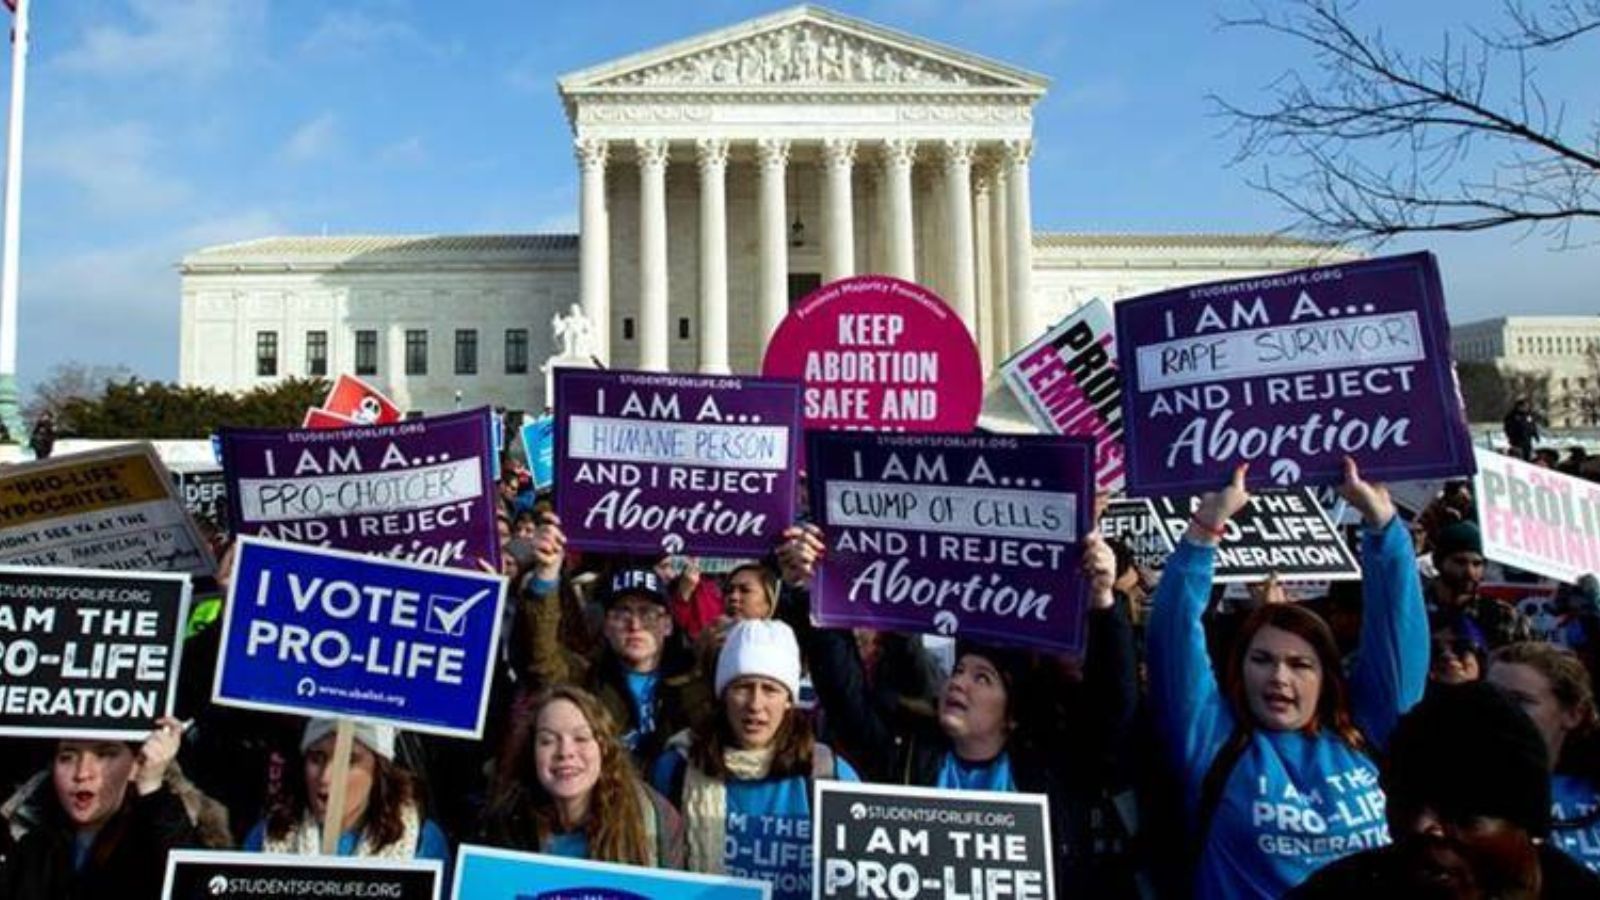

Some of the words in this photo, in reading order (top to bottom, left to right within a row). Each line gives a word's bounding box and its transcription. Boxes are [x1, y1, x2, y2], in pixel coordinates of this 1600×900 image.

[838, 313, 904, 346] KEEP
[1165, 310, 1174, 337] I
[1195, 297, 1270, 333] AM
[1290, 290, 1376, 321] A...
[1161, 338, 1228, 375] RAPE
[1256, 317, 1411, 363] SURVIVOR
[805, 351, 938, 383] ABORTION
[597, 389, 604, 414] I
[620, 391, 681, 419] AM
[696, 395, 761, 423] A...
[804, 389, 869, 419] SAFE
[881, 389, 938, 421] AND
[1150, 384, 1230, 418] AND
[1244, 382, 1253, 405] I
[1268, 366, 1415, 404] REJECT
[593, 424, 685, 458] HUMANE
[696, 429, 775, 460] PERSON
[1166, 408, 1410, 469] Abortion
[265, 449, 275, 475] I
[295, 445, 362, 474] AM
[380, 442, 450, 468] A...
[853, 451, 863, 478] I
[881, 453, 948, 483] AM
[966, 456, 1042, 487] A...
[258, 467, 457, 514] PRO-CHOICER
[574, 462, 641, 485] AND
[651, 466, 658, 487] I
[669, 469, 778, 494] REJECT
[257, 519, 329, 542] AND
[340, 519, 348, 538] I
[360, 502, 475, 536] REJECT
[584, 487, 767, 536] Abortion
[840, 489, 917, 519] CLUMP
[929, 494, 955, 523] OF
[973, 500, 1061, 530] CELLS
[1246, 495, 1307, 513] THE
[1166, 516, 1333, 543] PO-LIFE
[835, 530, 908, 554] AND
[920, 534, 927, 557] I
[940, 536, 1065, 570] REJECT
[1213, 545, 1344, 567] ENERATION
[257, 570, 271, 606] I
[288, 573, 421, 628] VOTE
[612, 571, 658, 592] LIFE
[848, 557, 1052, 621] Abortion
[0, 604, 56, 633] AM
[77, 608, 159, 637] THE
[0, 639, 168, 681] O-LIFE
[246, 619, 466, 685] PRO-LIFE
[0, 685, 157, 718] ERATION
[761, 815, 811, 839] THE
[868, 804, 1016, 828] STUDENTSFORLIFE.ORG
[1253, 789, 1387, 834] PRO-LIF
[723, 836, 812, 868] O-LIFE
[836, 824, 846, 852] I
[866, 826, 930, 856] AM
[948, 830, 1028, 862] THE
[229, 877, 402, 898] STUDENTSFORLIFE.ORG
[825, 858, 1043, 900] PRO-LIFE
